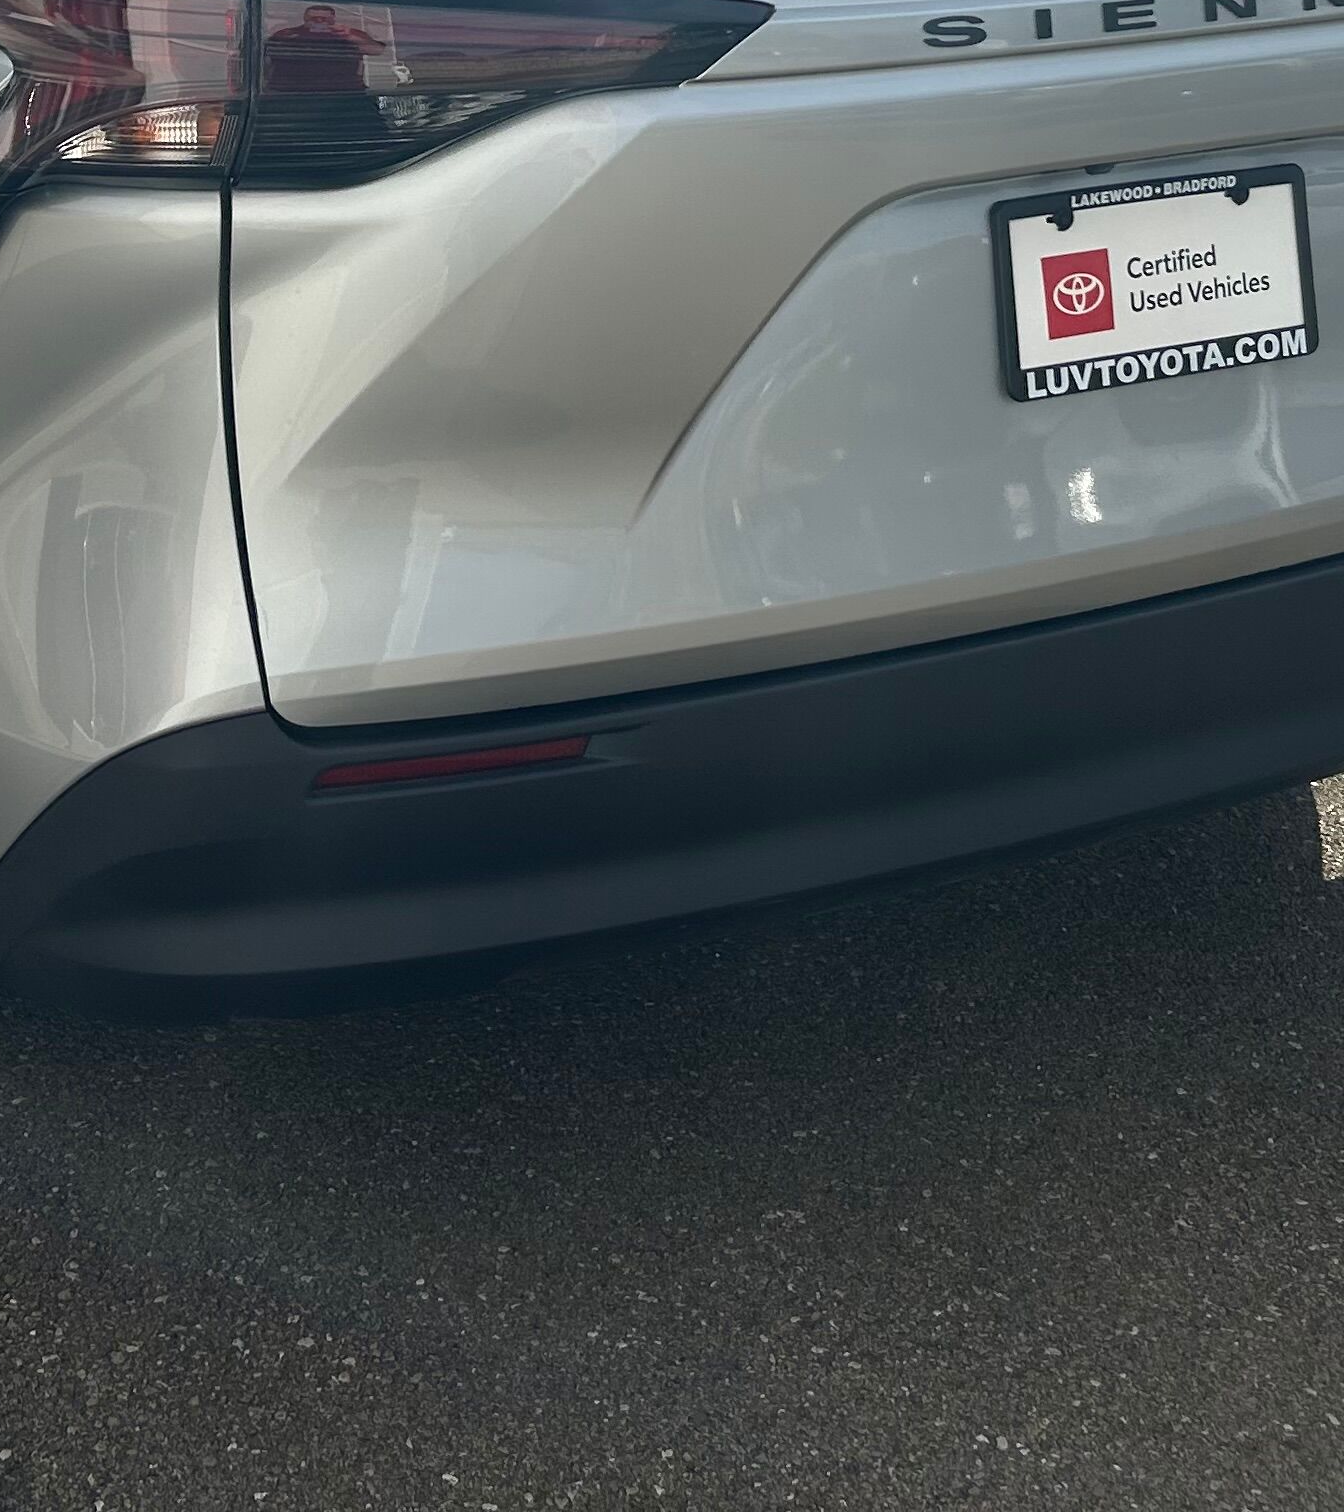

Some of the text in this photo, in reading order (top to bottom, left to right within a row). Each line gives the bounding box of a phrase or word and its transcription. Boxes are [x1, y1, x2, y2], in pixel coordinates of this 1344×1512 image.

[1070, 174, 1237, 209] LAKEWOOD BRADFORD
[1126, 243, 1218, 280] Certified
[1129, 271, 1271, 313] Used Vehicles
[1025, 326, 1308, 399] LUVTOYOTA.COM
